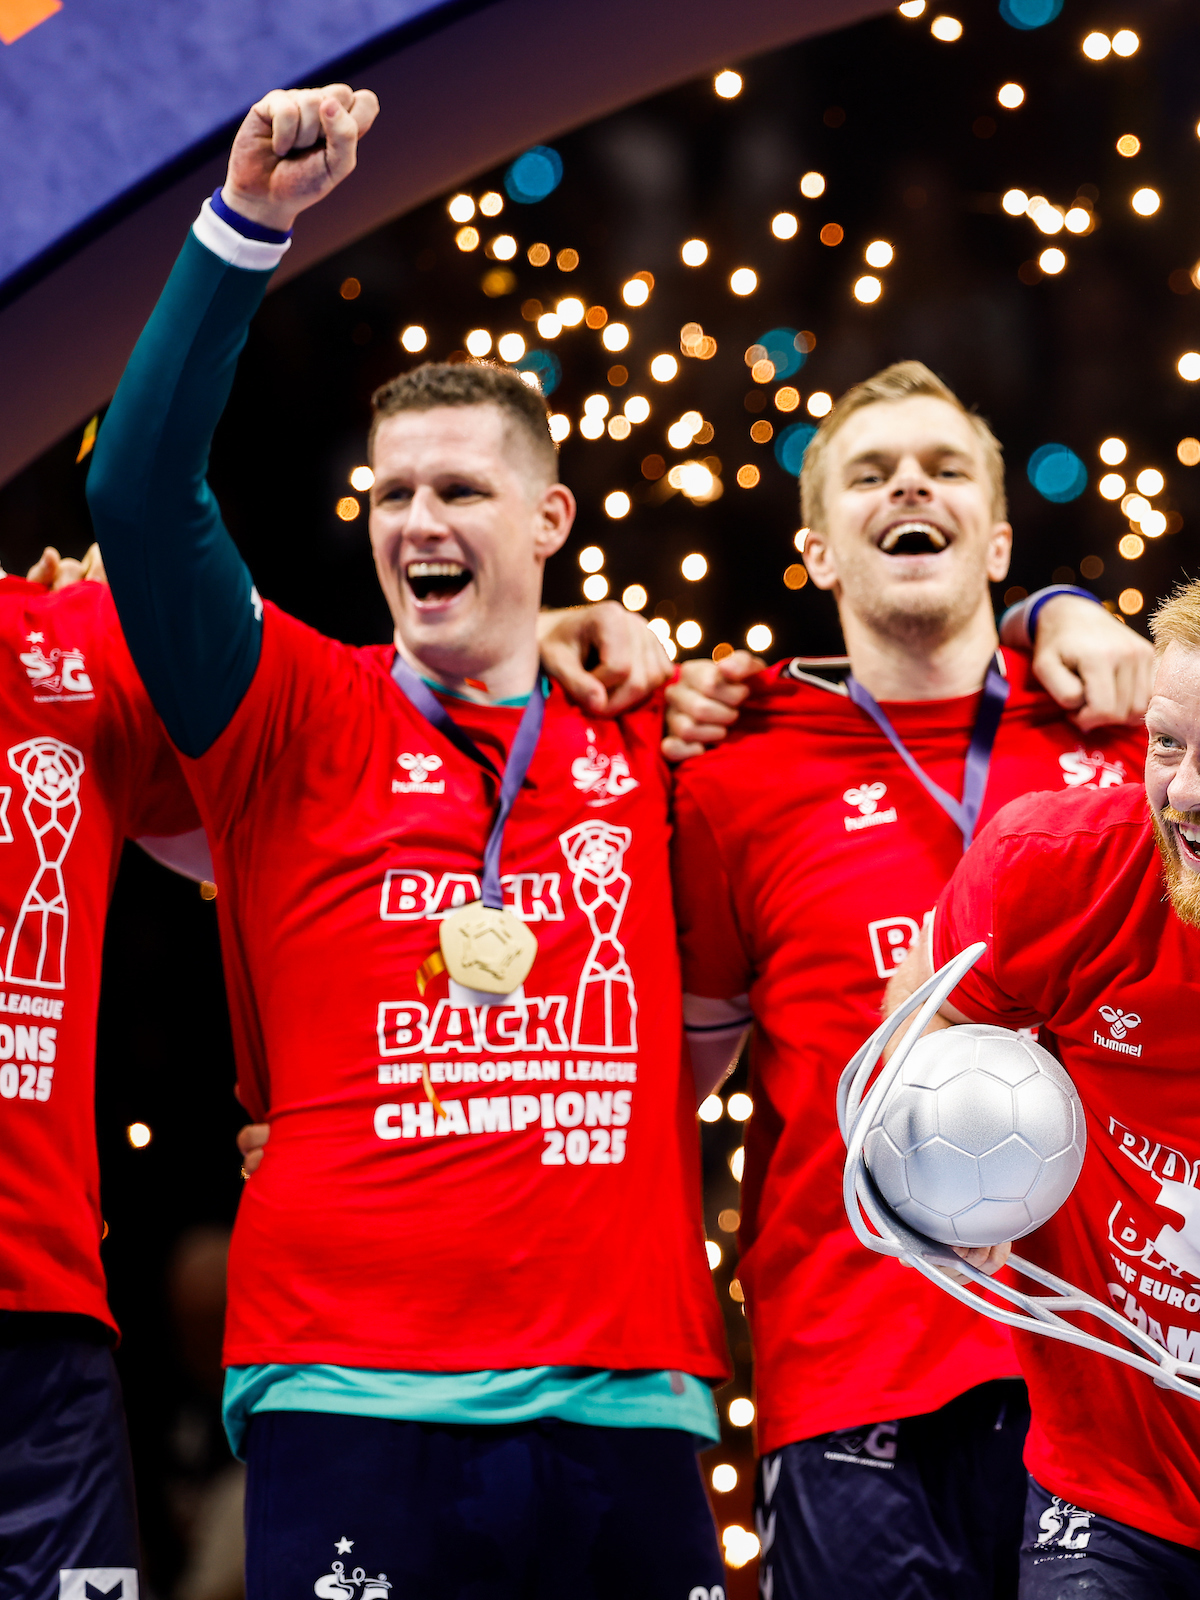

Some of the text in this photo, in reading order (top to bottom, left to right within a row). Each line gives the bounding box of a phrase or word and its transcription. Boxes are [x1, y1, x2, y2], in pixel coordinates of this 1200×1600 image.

[391, 779, 446, 795] hummel
[844, 807, 899, 832] hummel
[377, 995, 570, 1057] BACK
[1093, 1030, 1142, 1058] hummel
[0, 1062, 54, 1102] 025
[378, 1060, 637, 1084] EHF EUROPEAN LEAGUE
[373, 1090, 632, 1140] CHAMPIONS
[540, 1128, 628, 1166] 2025
